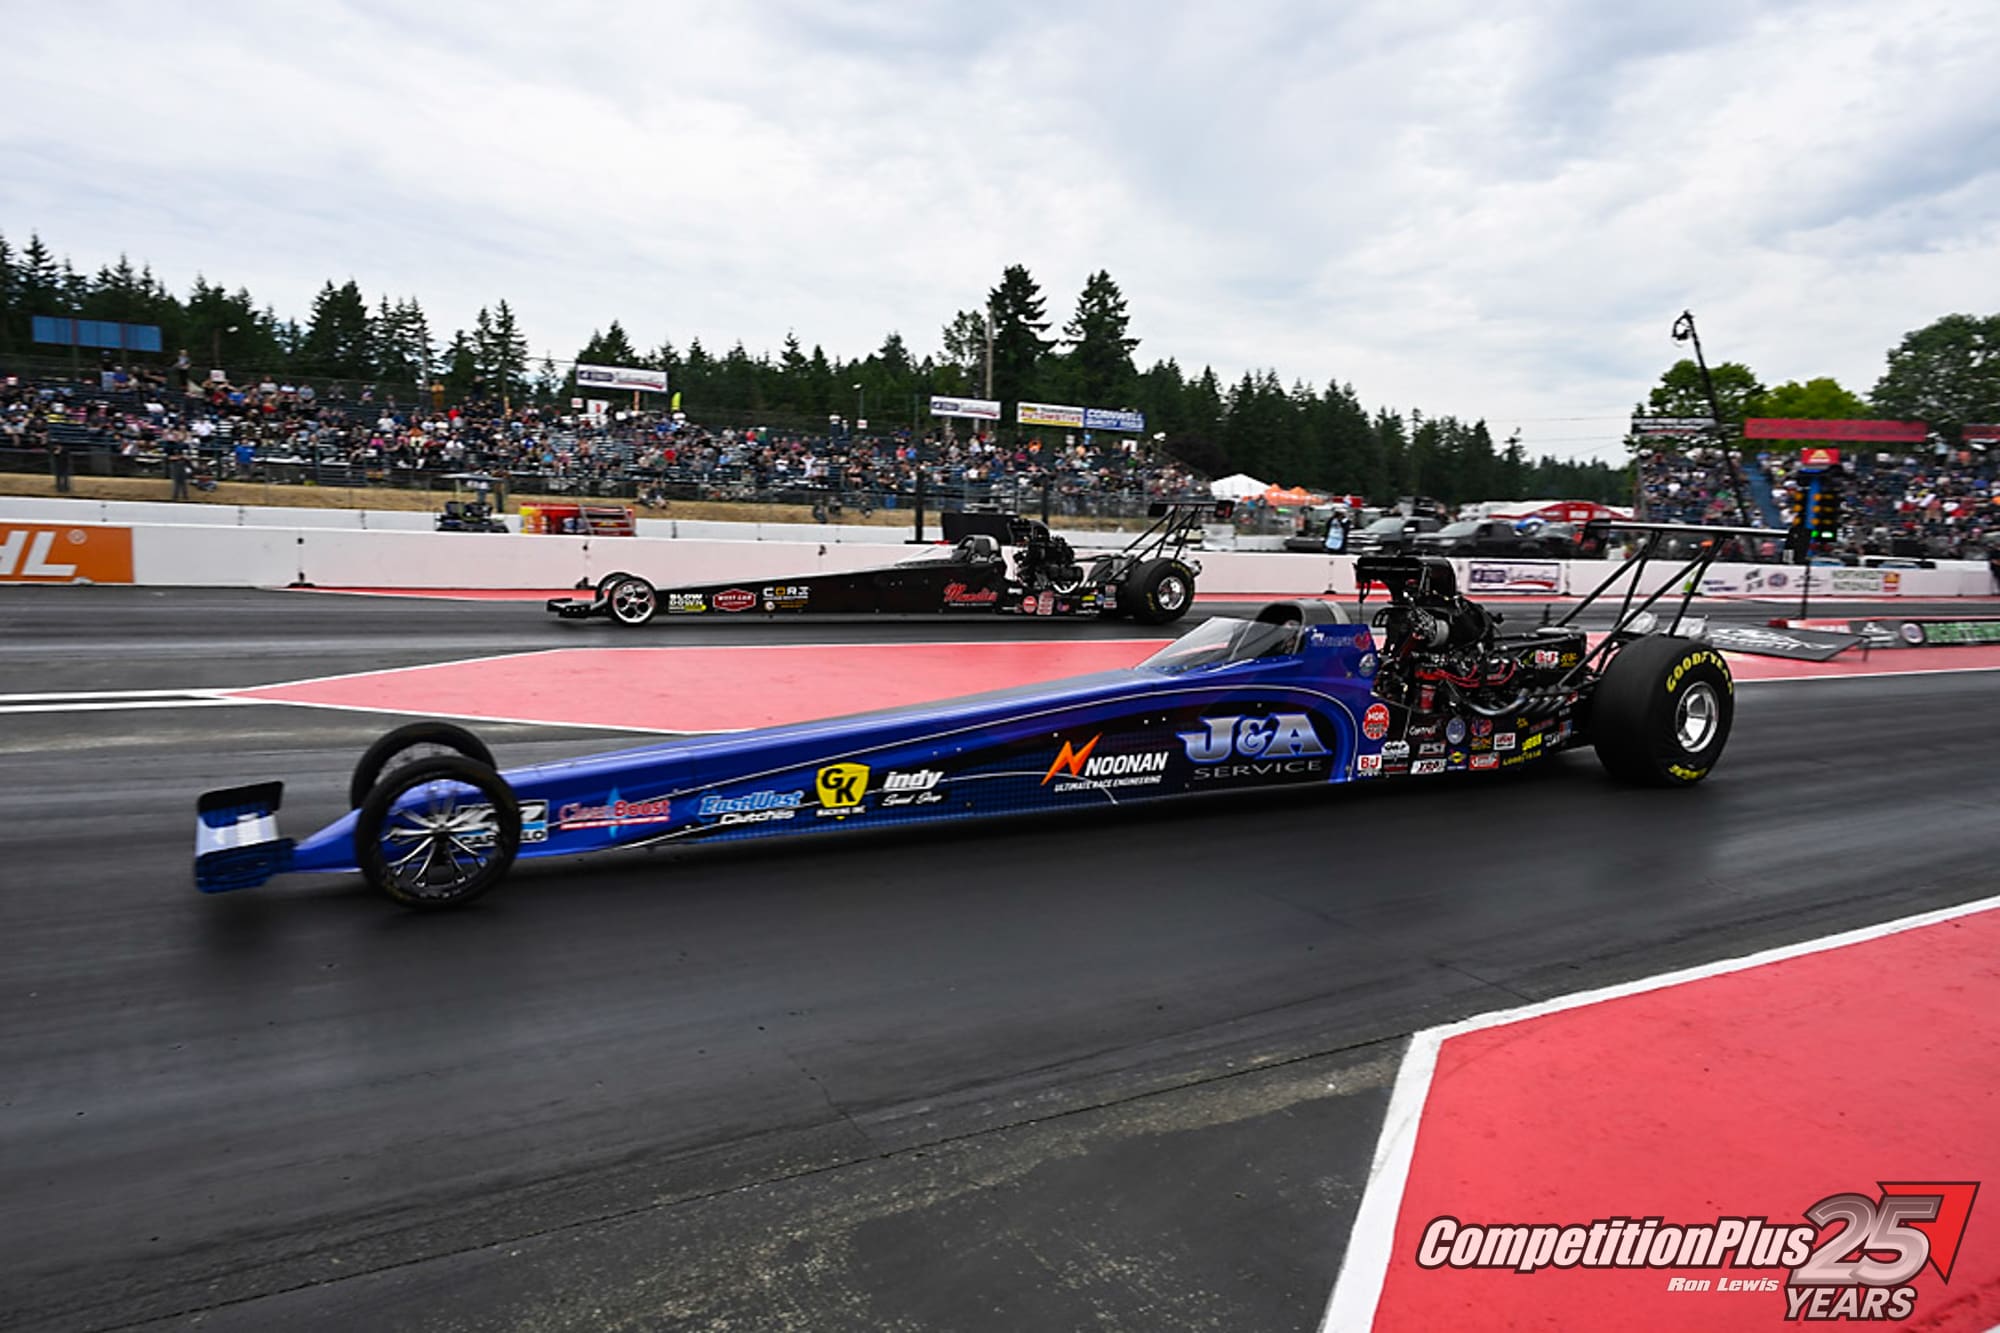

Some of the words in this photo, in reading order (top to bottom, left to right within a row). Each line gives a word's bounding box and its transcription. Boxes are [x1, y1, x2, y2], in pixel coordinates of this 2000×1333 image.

[1665, 651, 1734, 696] GOODYEAR
[1177, 713, 1331, 763] J&A
[1084, 752, 1169, 777] NOONAN
[1193, 760, 1322, 780] SERVICE
[821, 768, 858, 804] GK
[882, 769, 944, 791] indy
[698, 790, 805, 815] EastWest
[720, 810, 796, 825] Clutches
